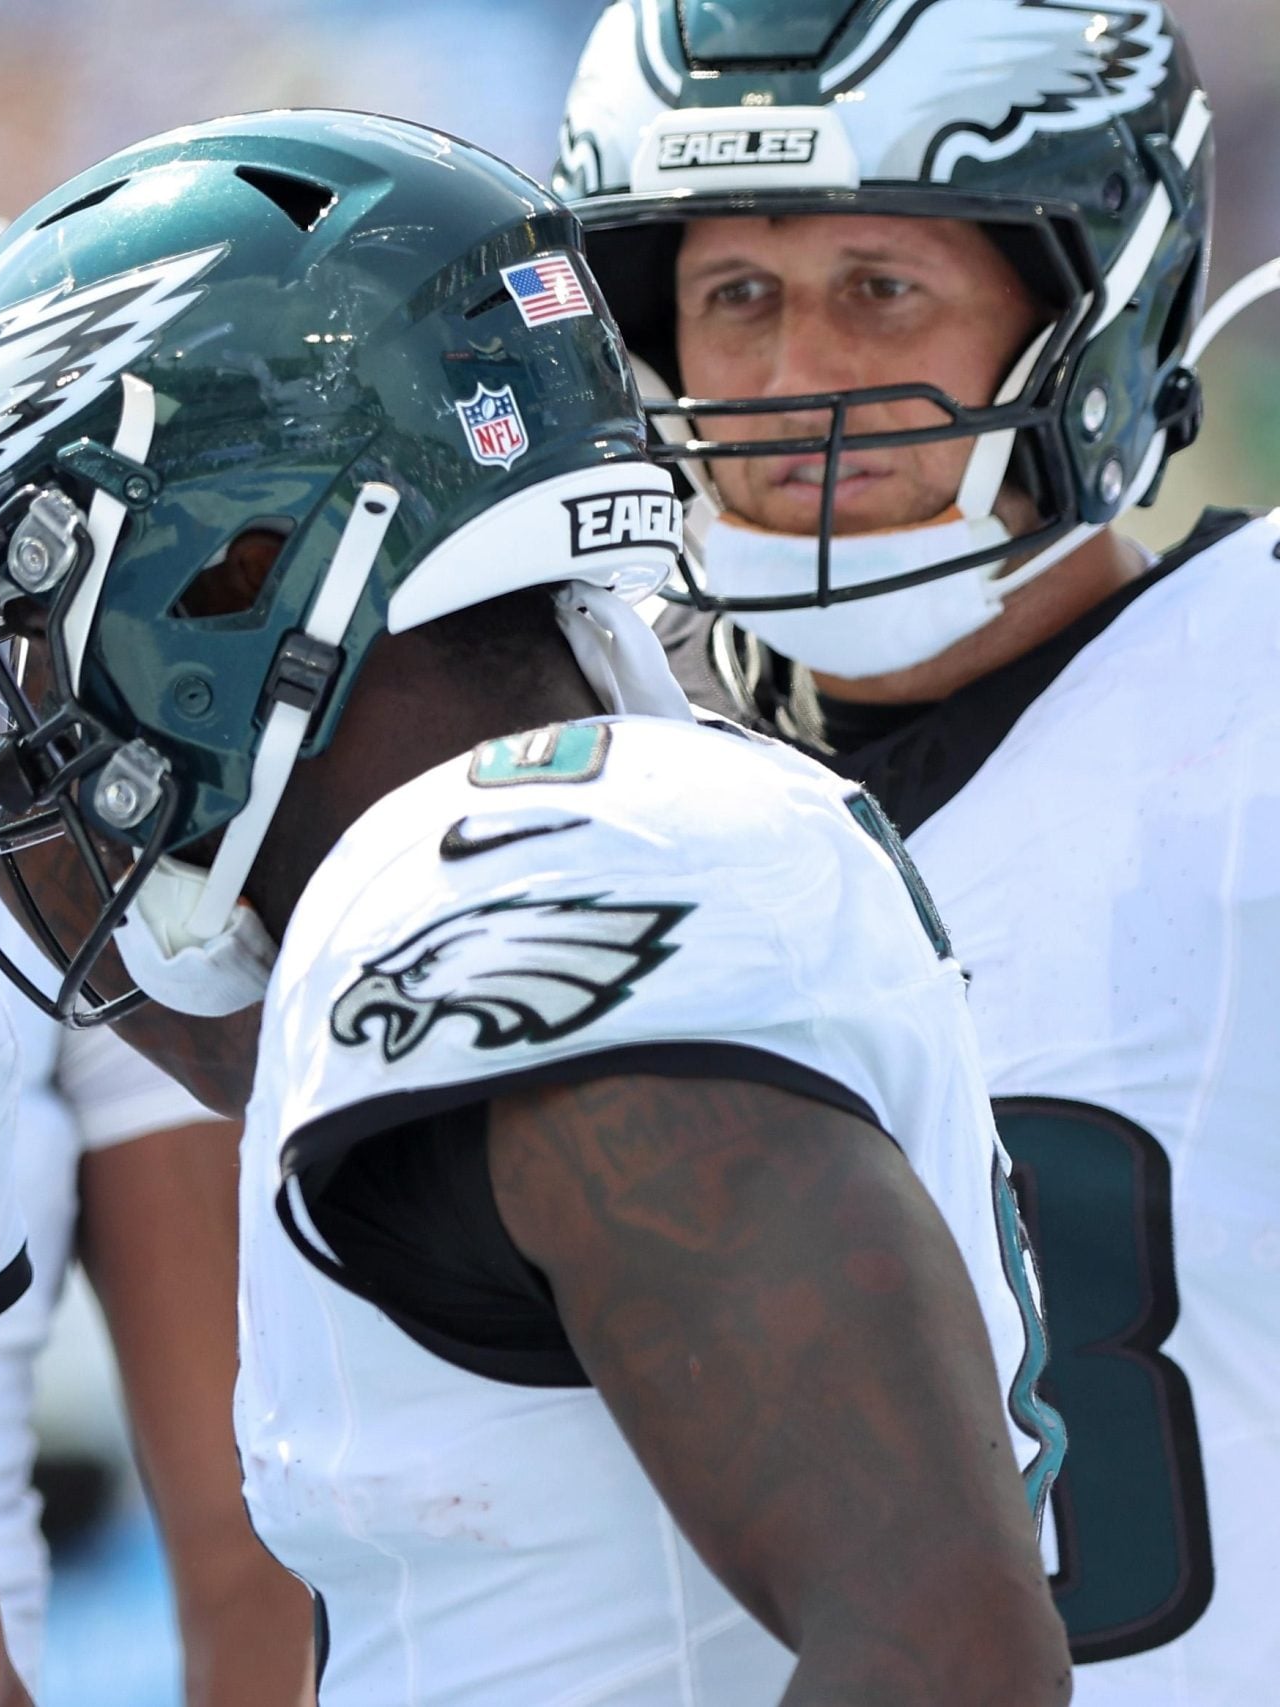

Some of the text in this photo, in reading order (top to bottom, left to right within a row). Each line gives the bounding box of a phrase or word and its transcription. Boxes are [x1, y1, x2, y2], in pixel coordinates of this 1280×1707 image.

[659, 130, 815, 169] EAGLES
[474, 419, 521, 455] NFL
[575, 494, 683, 553] EAGL
